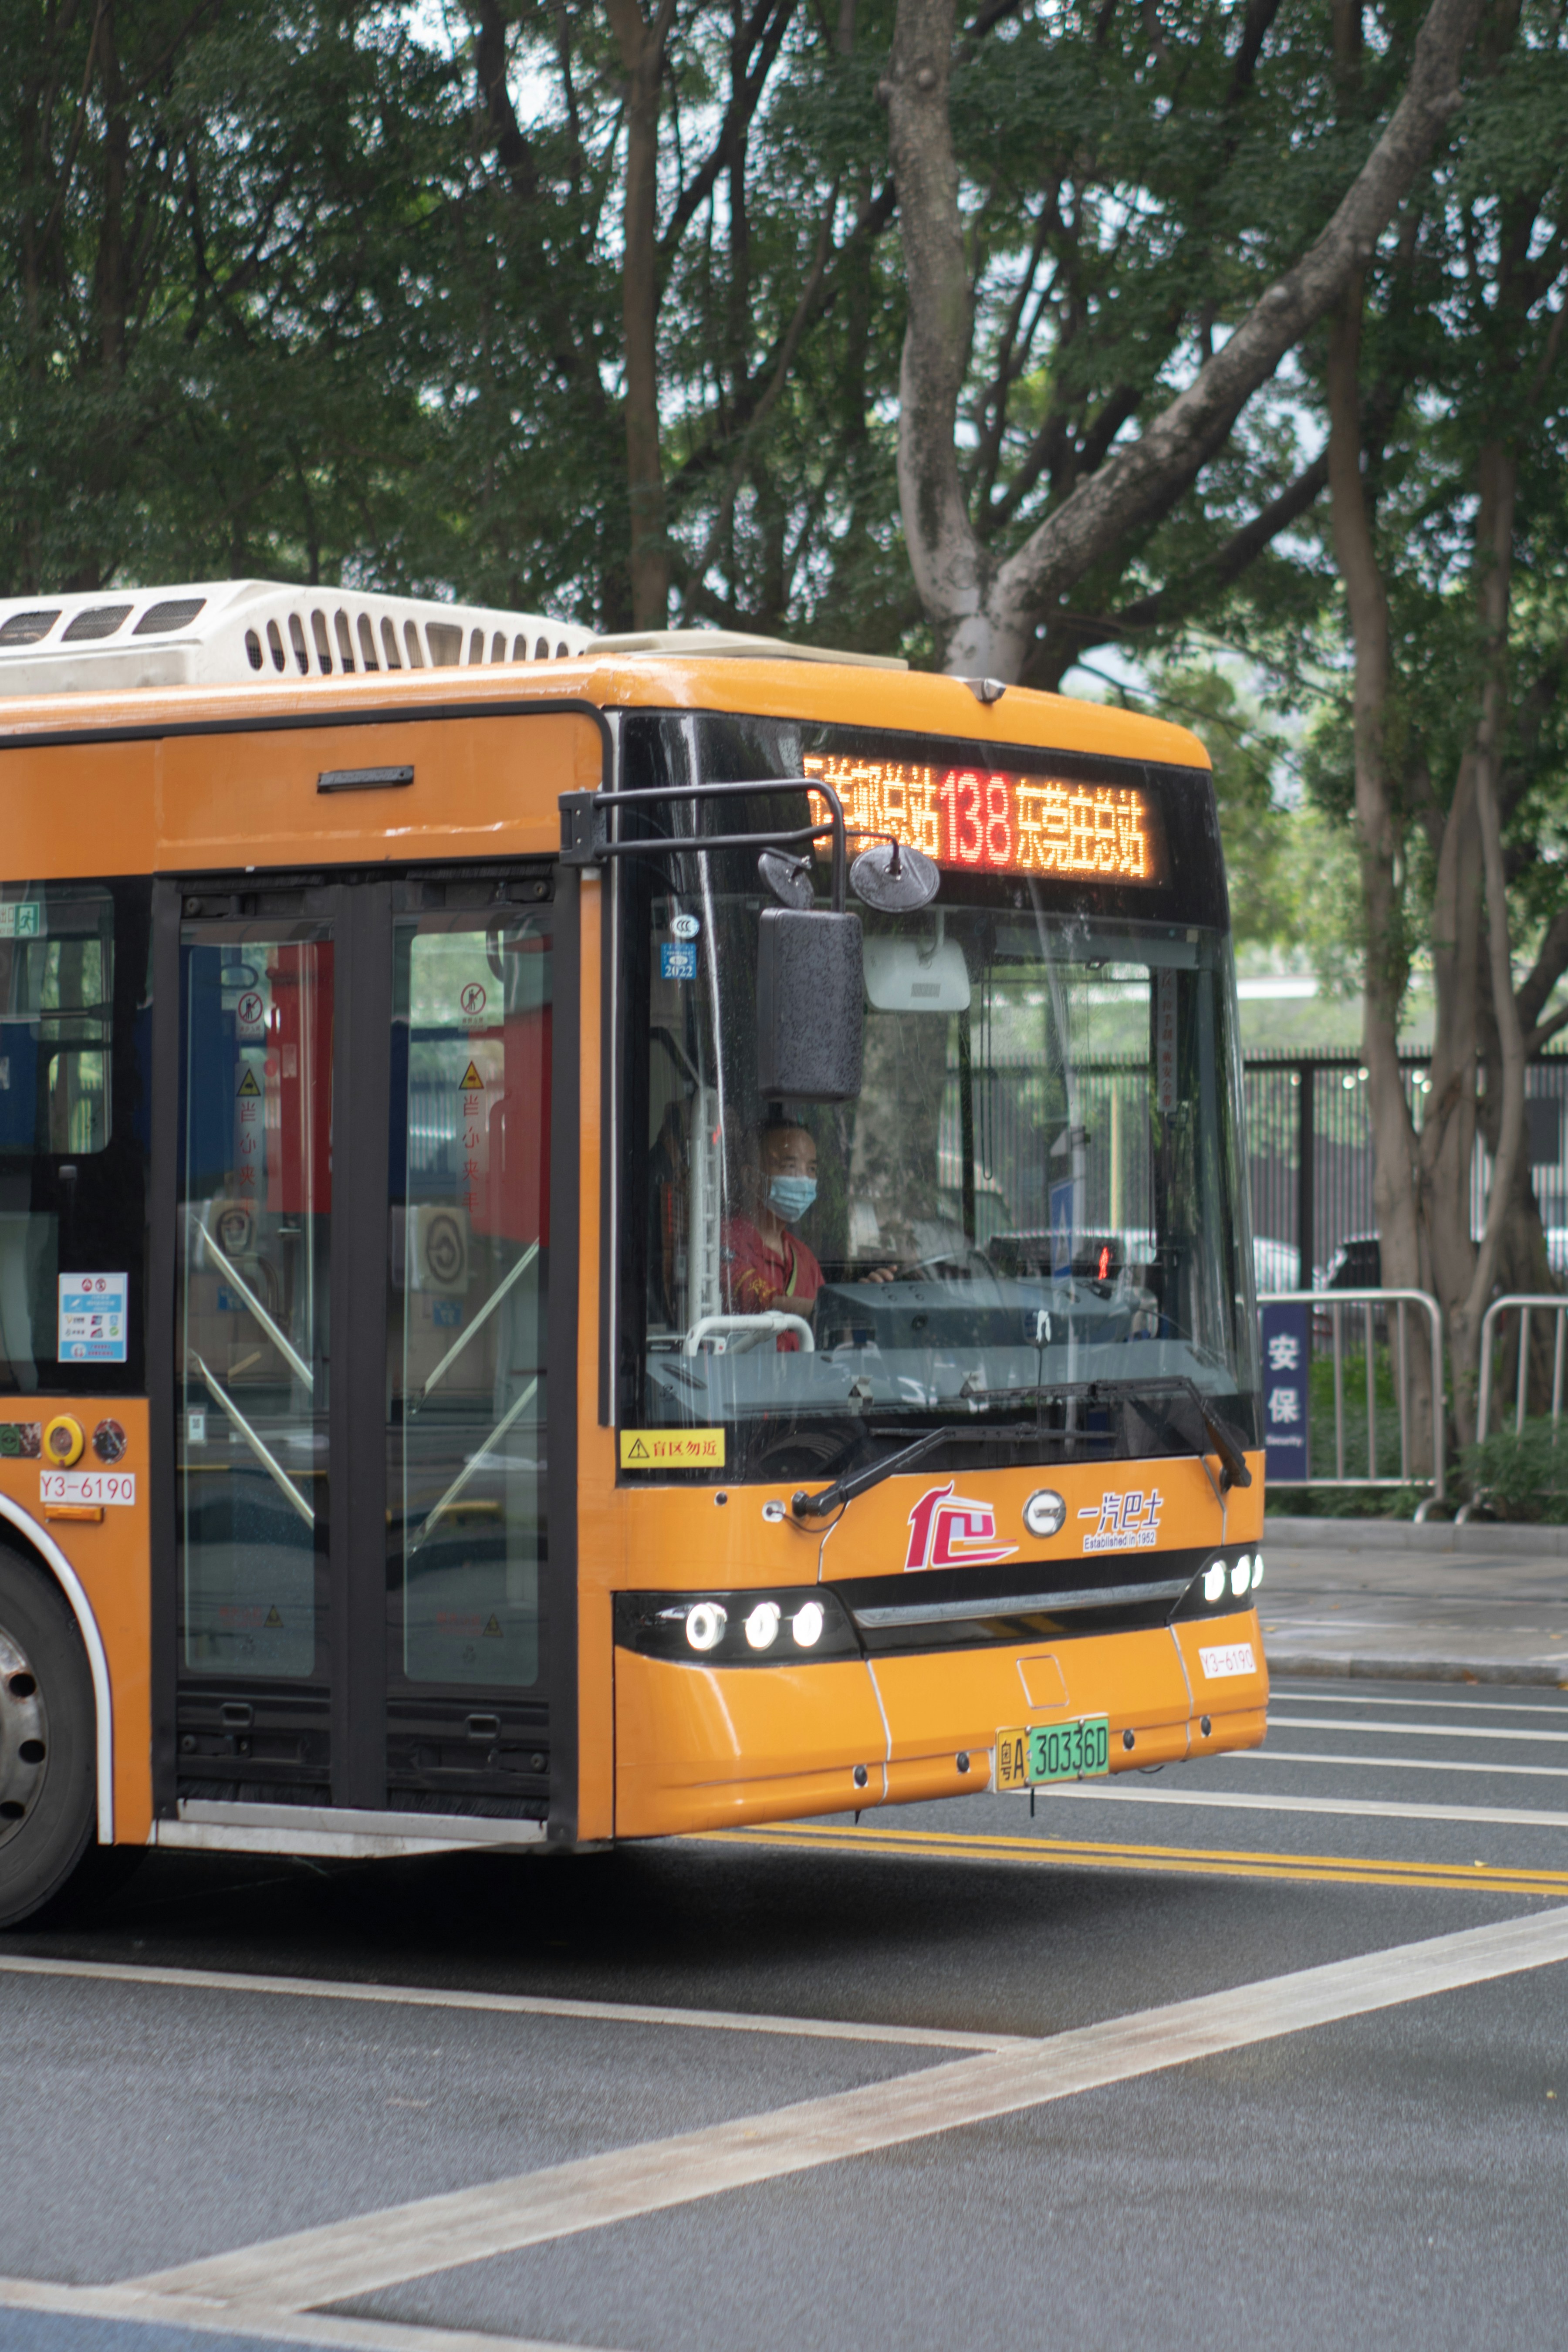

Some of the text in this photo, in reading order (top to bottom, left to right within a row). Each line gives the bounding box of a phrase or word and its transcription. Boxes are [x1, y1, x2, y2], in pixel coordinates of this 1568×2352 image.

[940, 770, 1011, 865] 138
[665, 964, 693, 978] 2022
[1268, 1334, 1299, 1423] 安保
[653, 1440, 717, 1457] 盲区勿近
[1266, 1435, 1303, 1447] Security
[41, 1476, 133, 1500] Y3-6190
[1079, 1491, 1162, 1531] 一汽巴士
[1085, 1532, 1155, 1549] Established in 1952
[1201, 1649, 1253, 1673] Y3-6190
